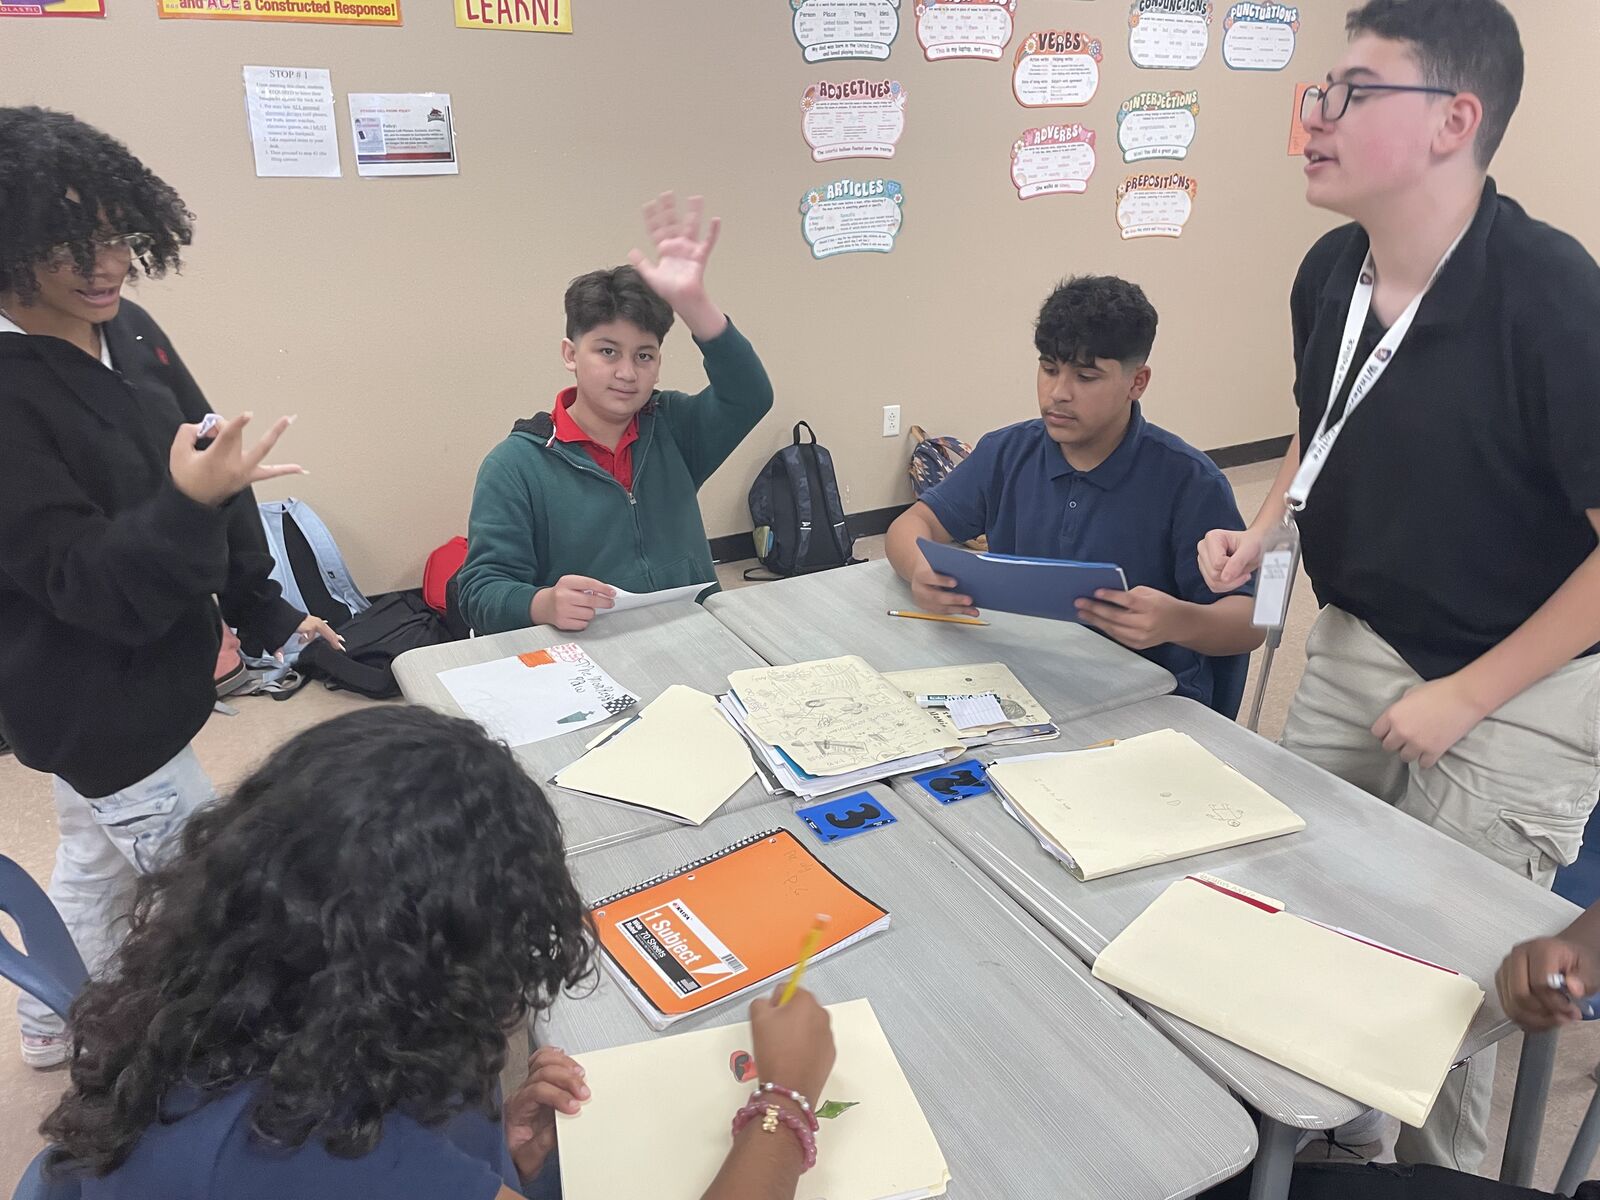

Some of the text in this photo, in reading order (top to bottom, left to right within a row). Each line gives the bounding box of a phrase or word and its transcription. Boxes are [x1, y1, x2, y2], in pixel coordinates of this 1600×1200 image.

[255, 0, 331, 13] Constructed
[335, 2, 395, 18] Response!
[1140, 0, 1206, 14] CONJUNCTIONS
[1231, 3, 1297, 22] PUNCTUATIONS
[1039, 32, 1080, 52] VERBS
[270, 70, 294, 78] STOP
[820, 80, 890, 99] ADJECTIVES
[1129, 91, 1197, 111] INTERJECTIONS
[1034, 125, 1078, 144] ADVERBS
[827, 180, 884, 199] ARTICLES
[1126, 173, 1190, 192] PREPOSITIONS
[825, 803, 880, 829] 3
[645, 912, 662, 921] 1
[640, 930, 651, 940] 70
[647, 937, 667, 958] Sheets
[652, 918, 702, 966] Subject
